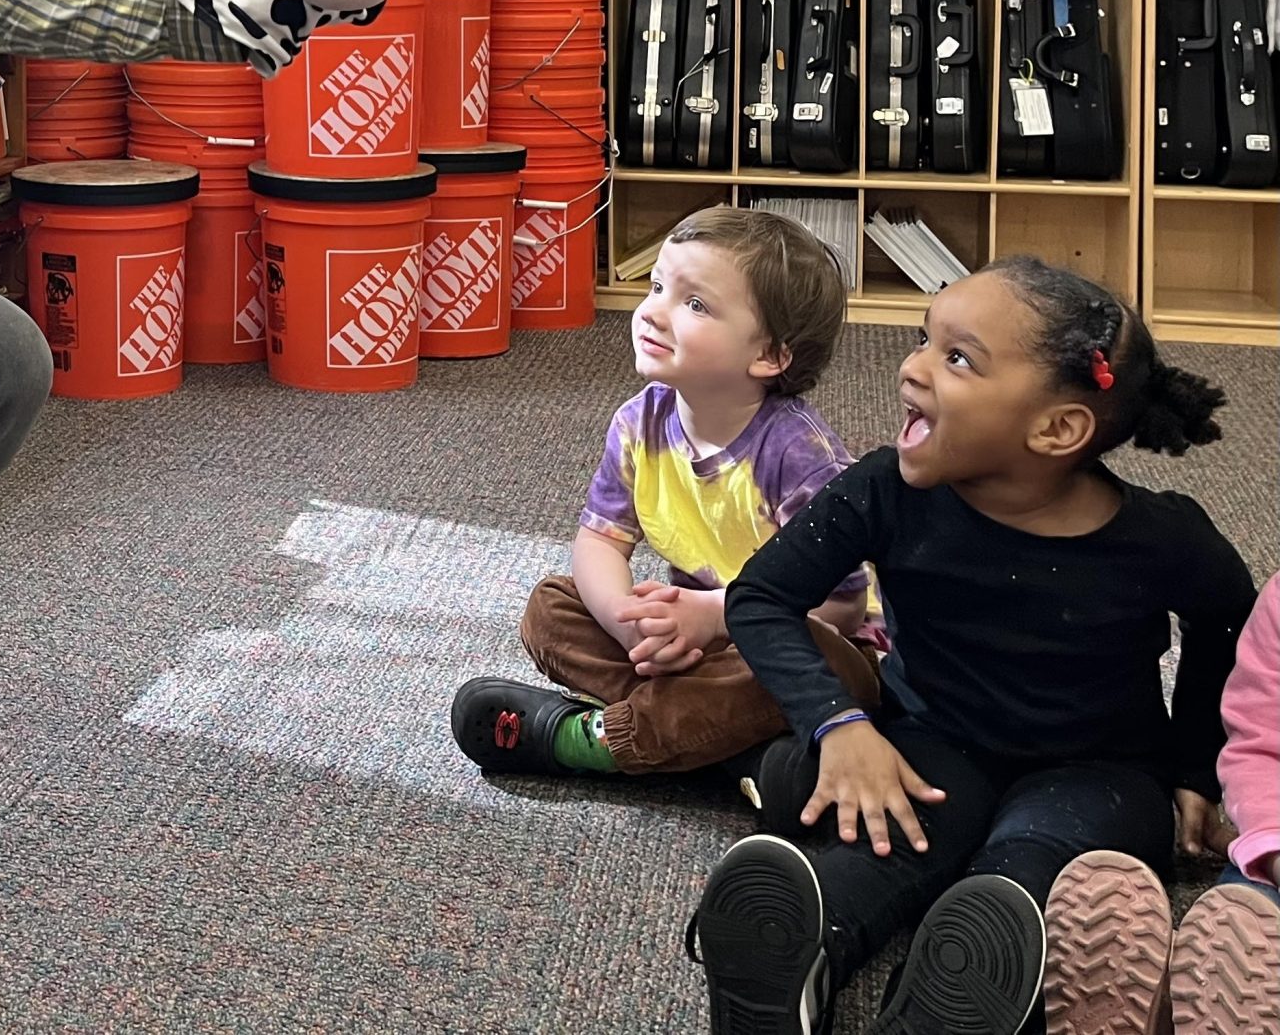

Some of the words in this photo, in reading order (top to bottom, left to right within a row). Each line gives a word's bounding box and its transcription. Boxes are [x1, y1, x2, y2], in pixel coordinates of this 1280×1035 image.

[311, 36, 414, 156] HOME
[320, 49, 371, 97] THE
[355, 79, 414, 155] DEPOT
[120, 251, 185, 372] HOM
[129, 265, 170, 315] THE
[329, 247, 422, 366] HOME
[340, 263, 392, 309] THE
[420, 220, 500, 331] HOME
[442, 260, 500, 330] DEPOT
[375, 290, 420, 364] DEPO
